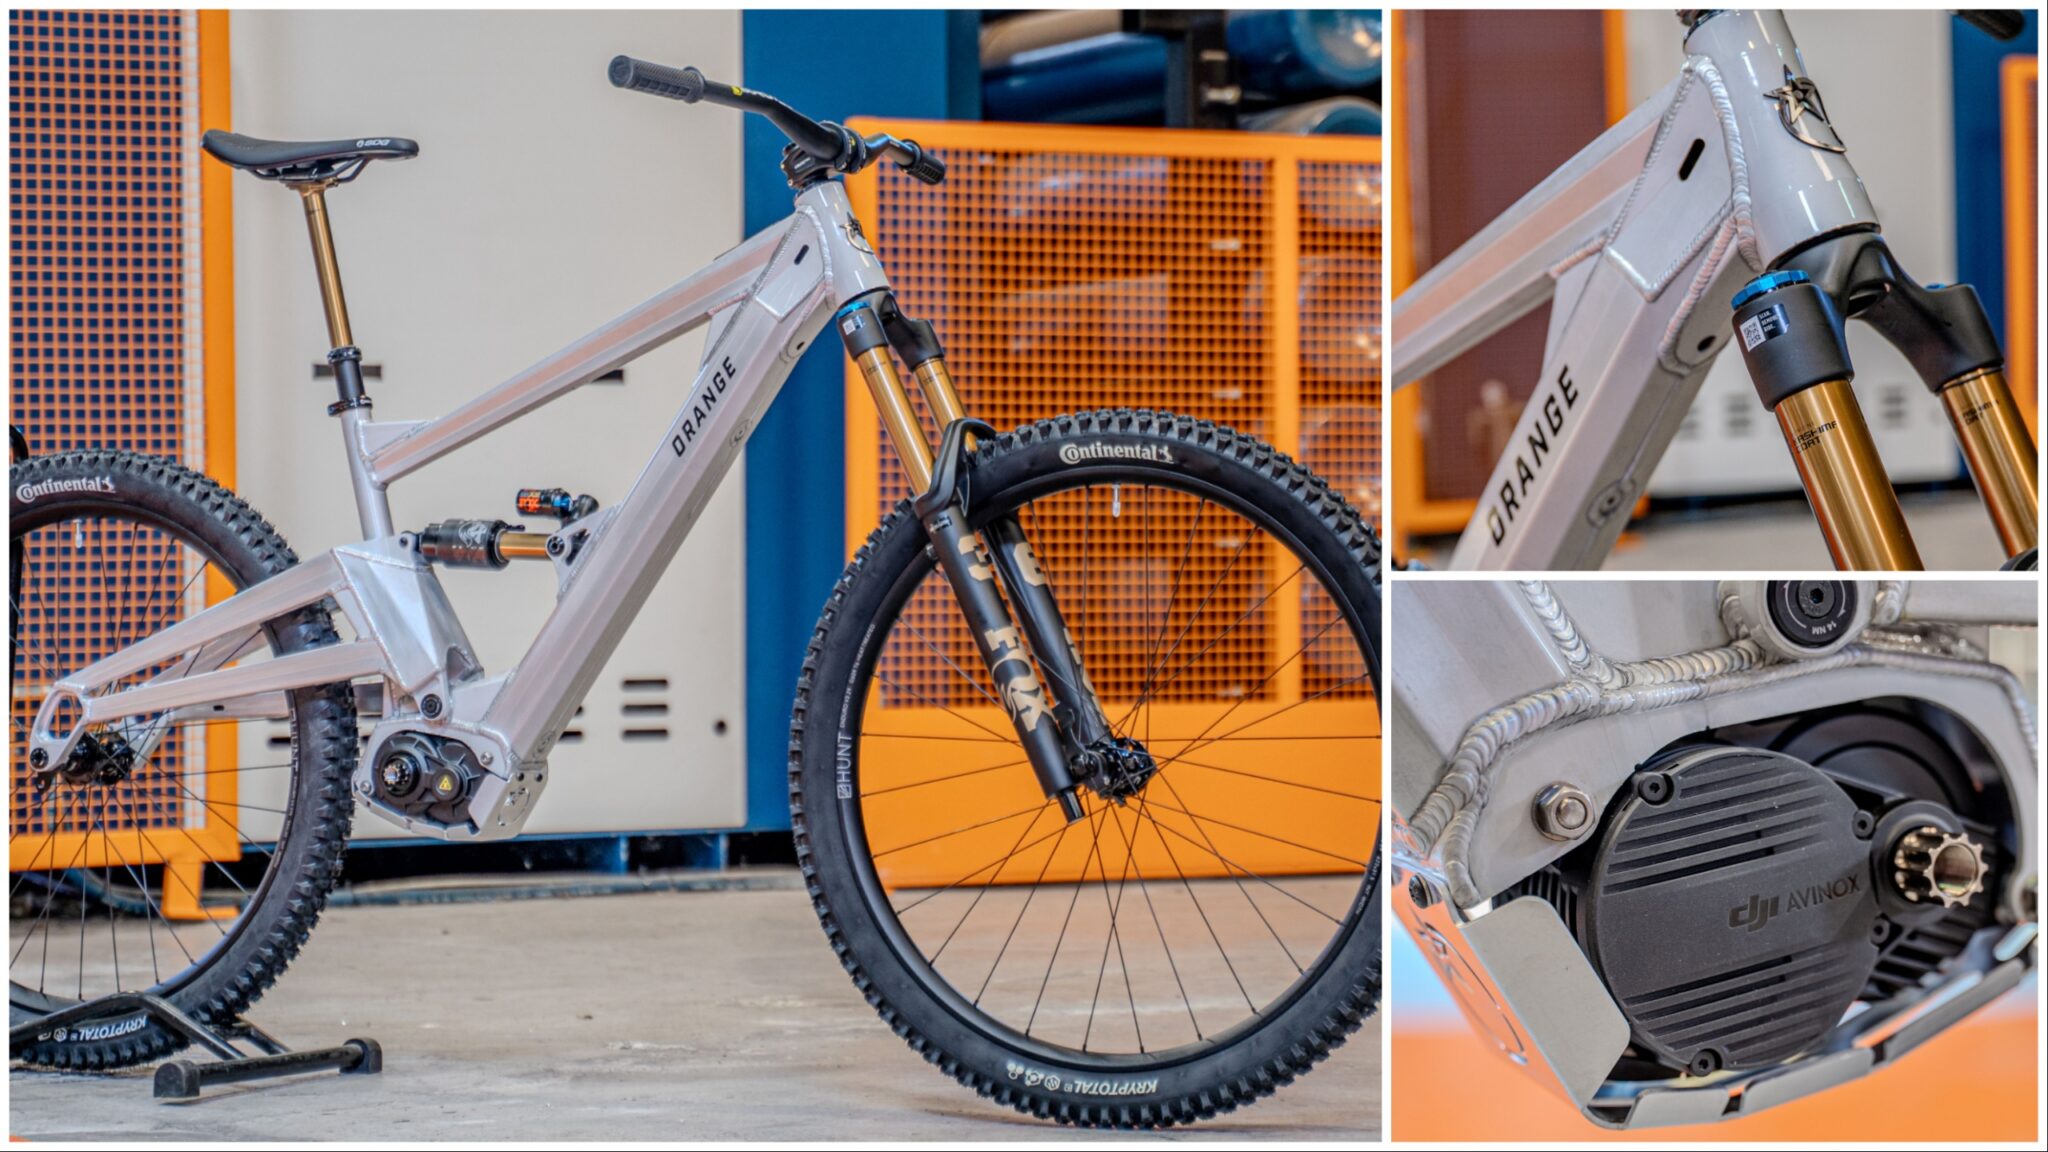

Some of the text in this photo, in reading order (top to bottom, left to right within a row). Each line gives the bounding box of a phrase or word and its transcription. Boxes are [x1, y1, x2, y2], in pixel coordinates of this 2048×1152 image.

[671, 355, 737, 458] ORANGE
[1059, 441, 1157, 465] Continental
[1487, 364, 1579, 547] ORANGE
[15, 475, 102, 504] Continental
[984, 625, 1059, 733] FOX
[837, 731, 852, 783] HUNT
[1786, 873, 1861, 913] AVINOX
[79, 1015, 148, 1041] KRYPTOTAL
[1074, 1078, 1158, 1095] KRYPTOTAL
